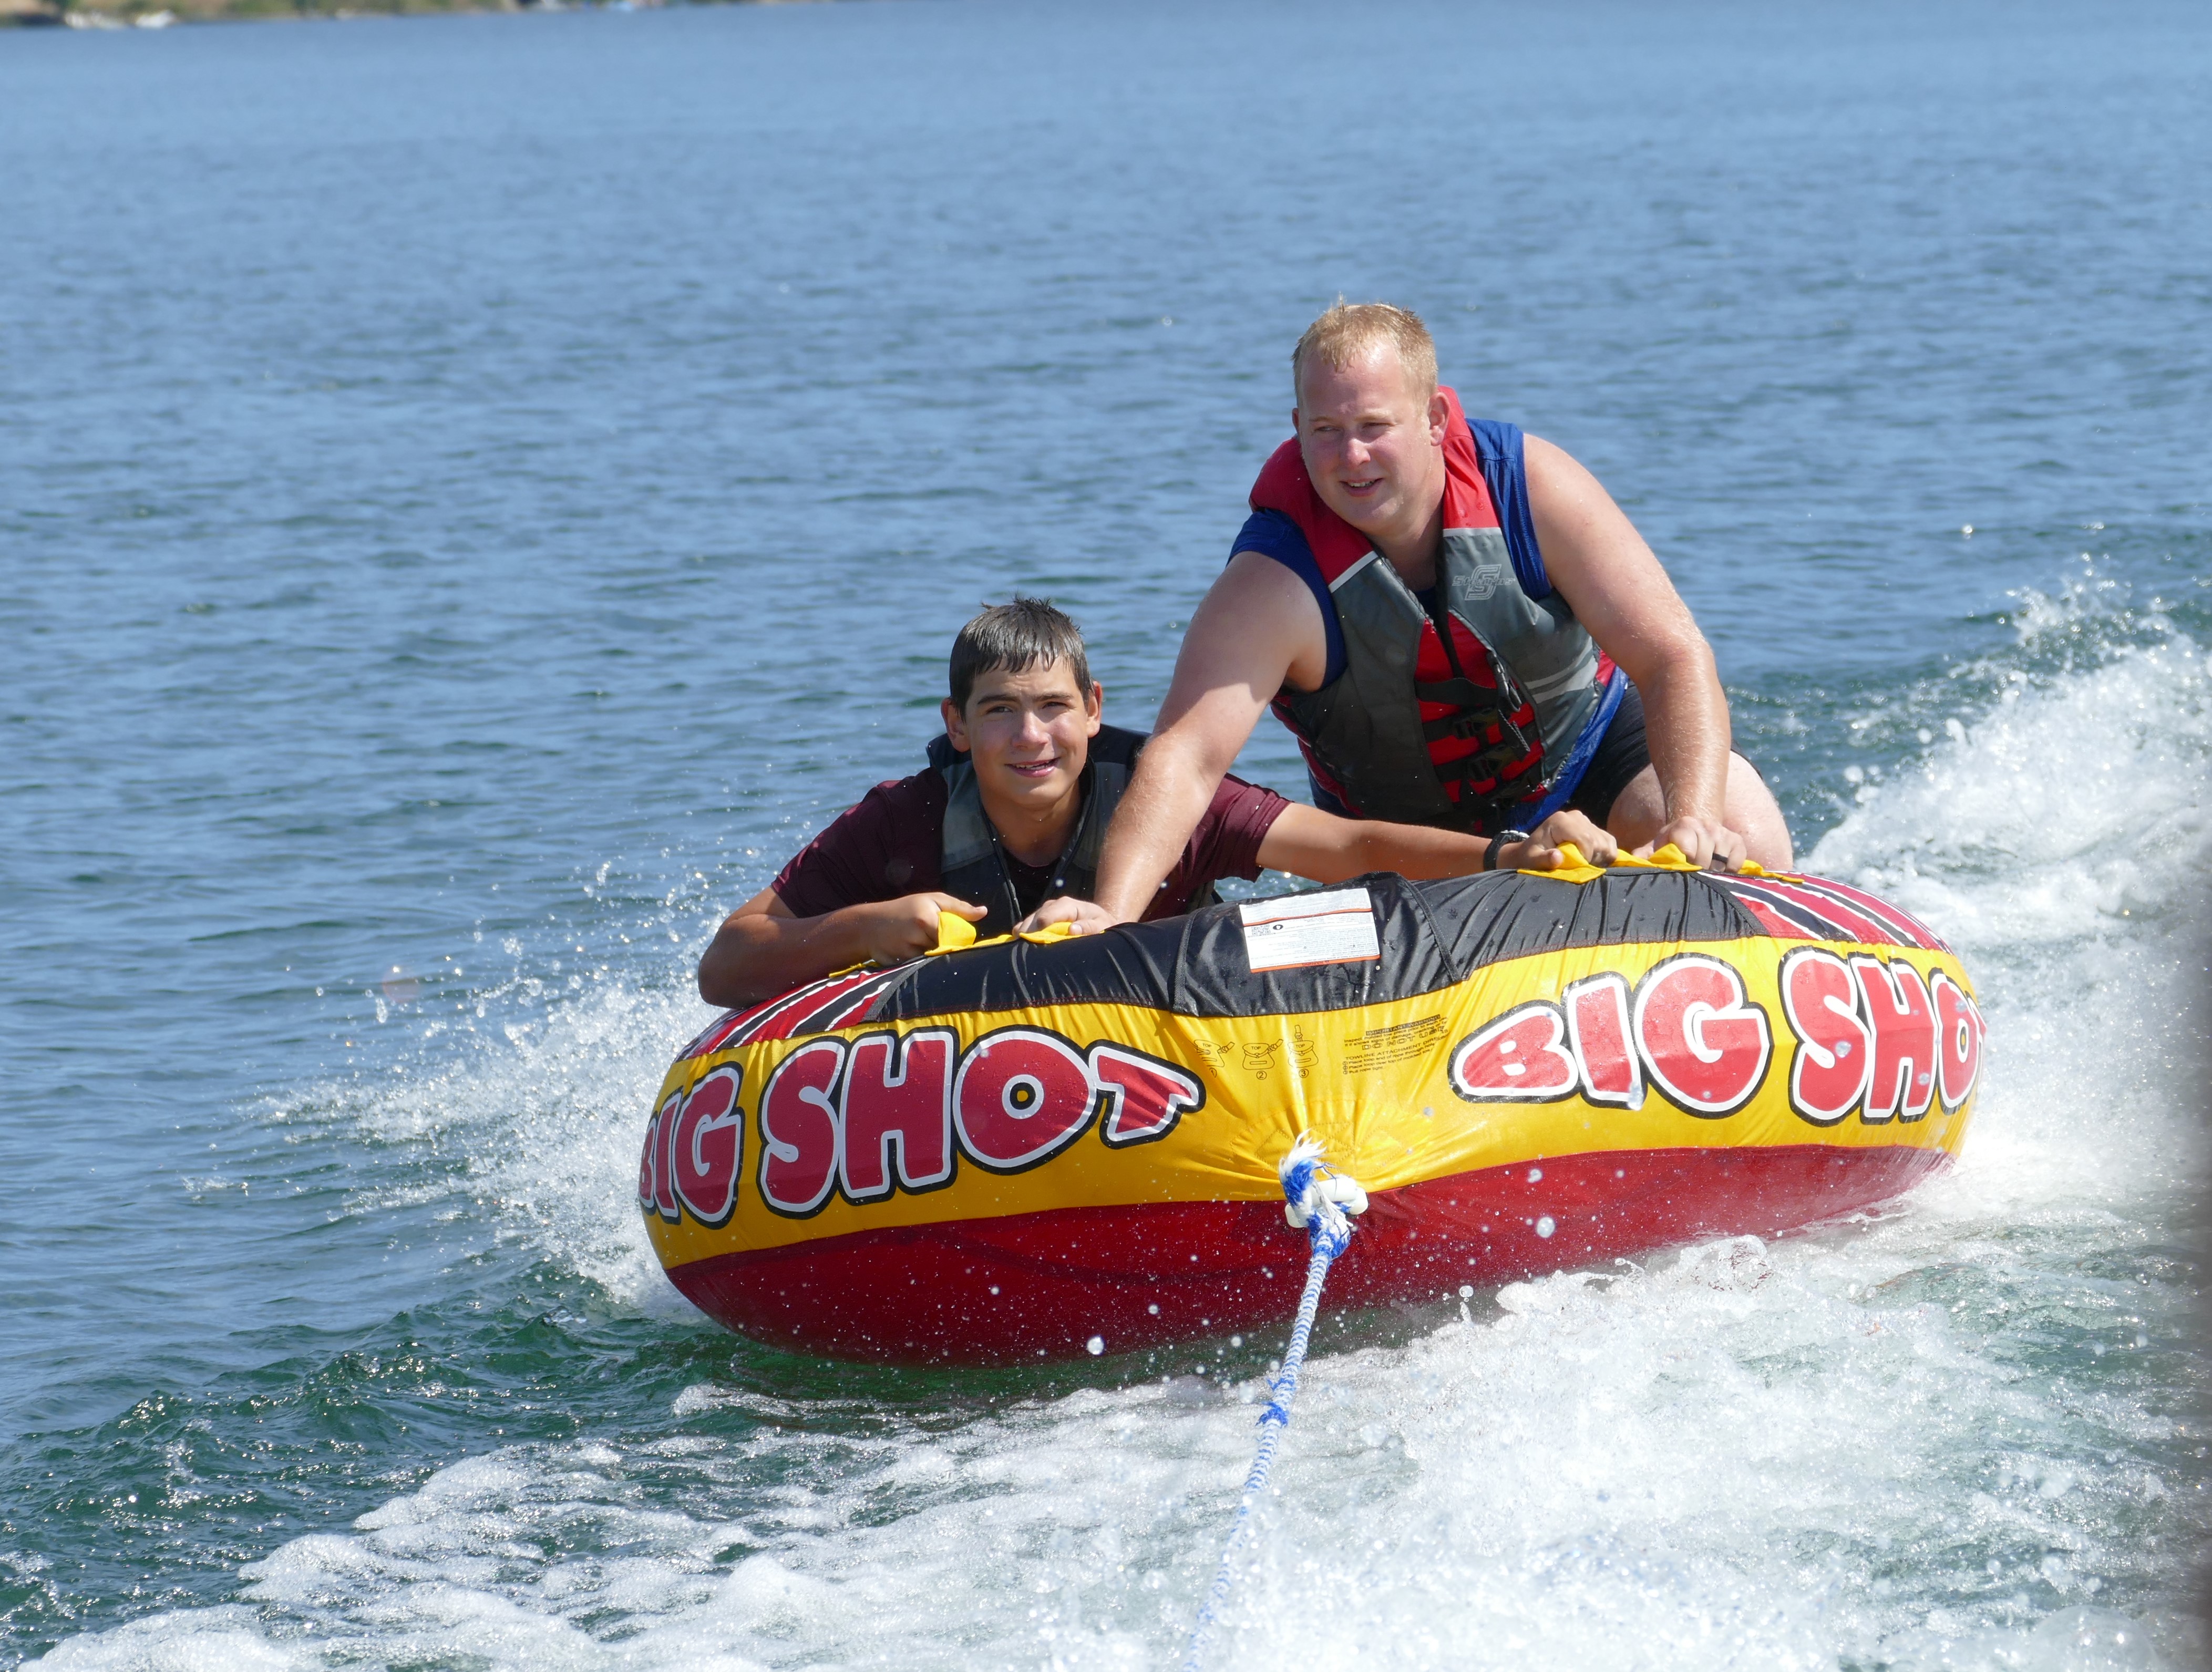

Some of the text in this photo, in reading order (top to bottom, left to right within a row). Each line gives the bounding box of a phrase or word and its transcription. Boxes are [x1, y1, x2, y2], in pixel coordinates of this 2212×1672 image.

[1452, 575, 1514, 586] Stearns
[1366, 1015, 1440, 1036] IMPORTANT WARNING
[1387, 1036, 1415, 1047] NOT
[1448, 952, 1772, 1120] BIG
[1377, 1043, 1421, 1056] ATTACHMENT
[638, 1024, 1206, 1230] BIG SHOT
